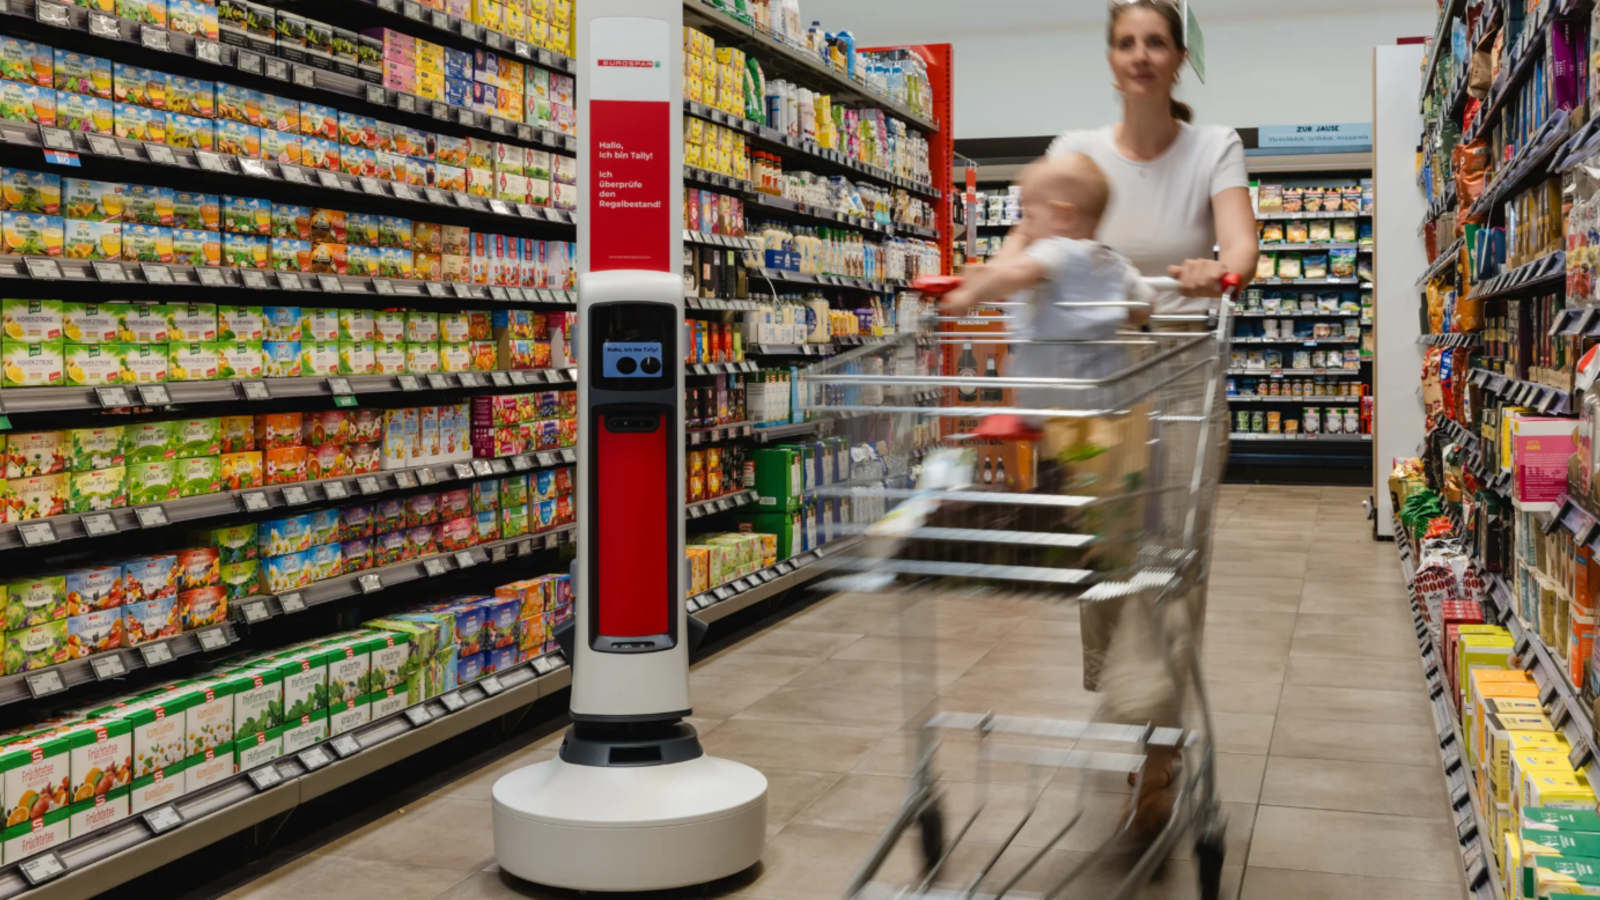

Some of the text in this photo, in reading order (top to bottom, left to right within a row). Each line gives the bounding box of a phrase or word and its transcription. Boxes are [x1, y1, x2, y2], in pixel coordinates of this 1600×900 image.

[599, 142, 624, 150] Hallo,
[614, 151, 628, 159] bin
[630, 152, 653, 161] Tally!
[599, 180, 642, 189] überprüfe
[599, 199, 662, 209] Regalbestand!
[88, 744, 118, 760] Früchtetee
[22, 764, 54, 782] Früchtetee
[86, 806, 115, 826] Früchtetee
[22, 832, 54, 852] Früchtetee
